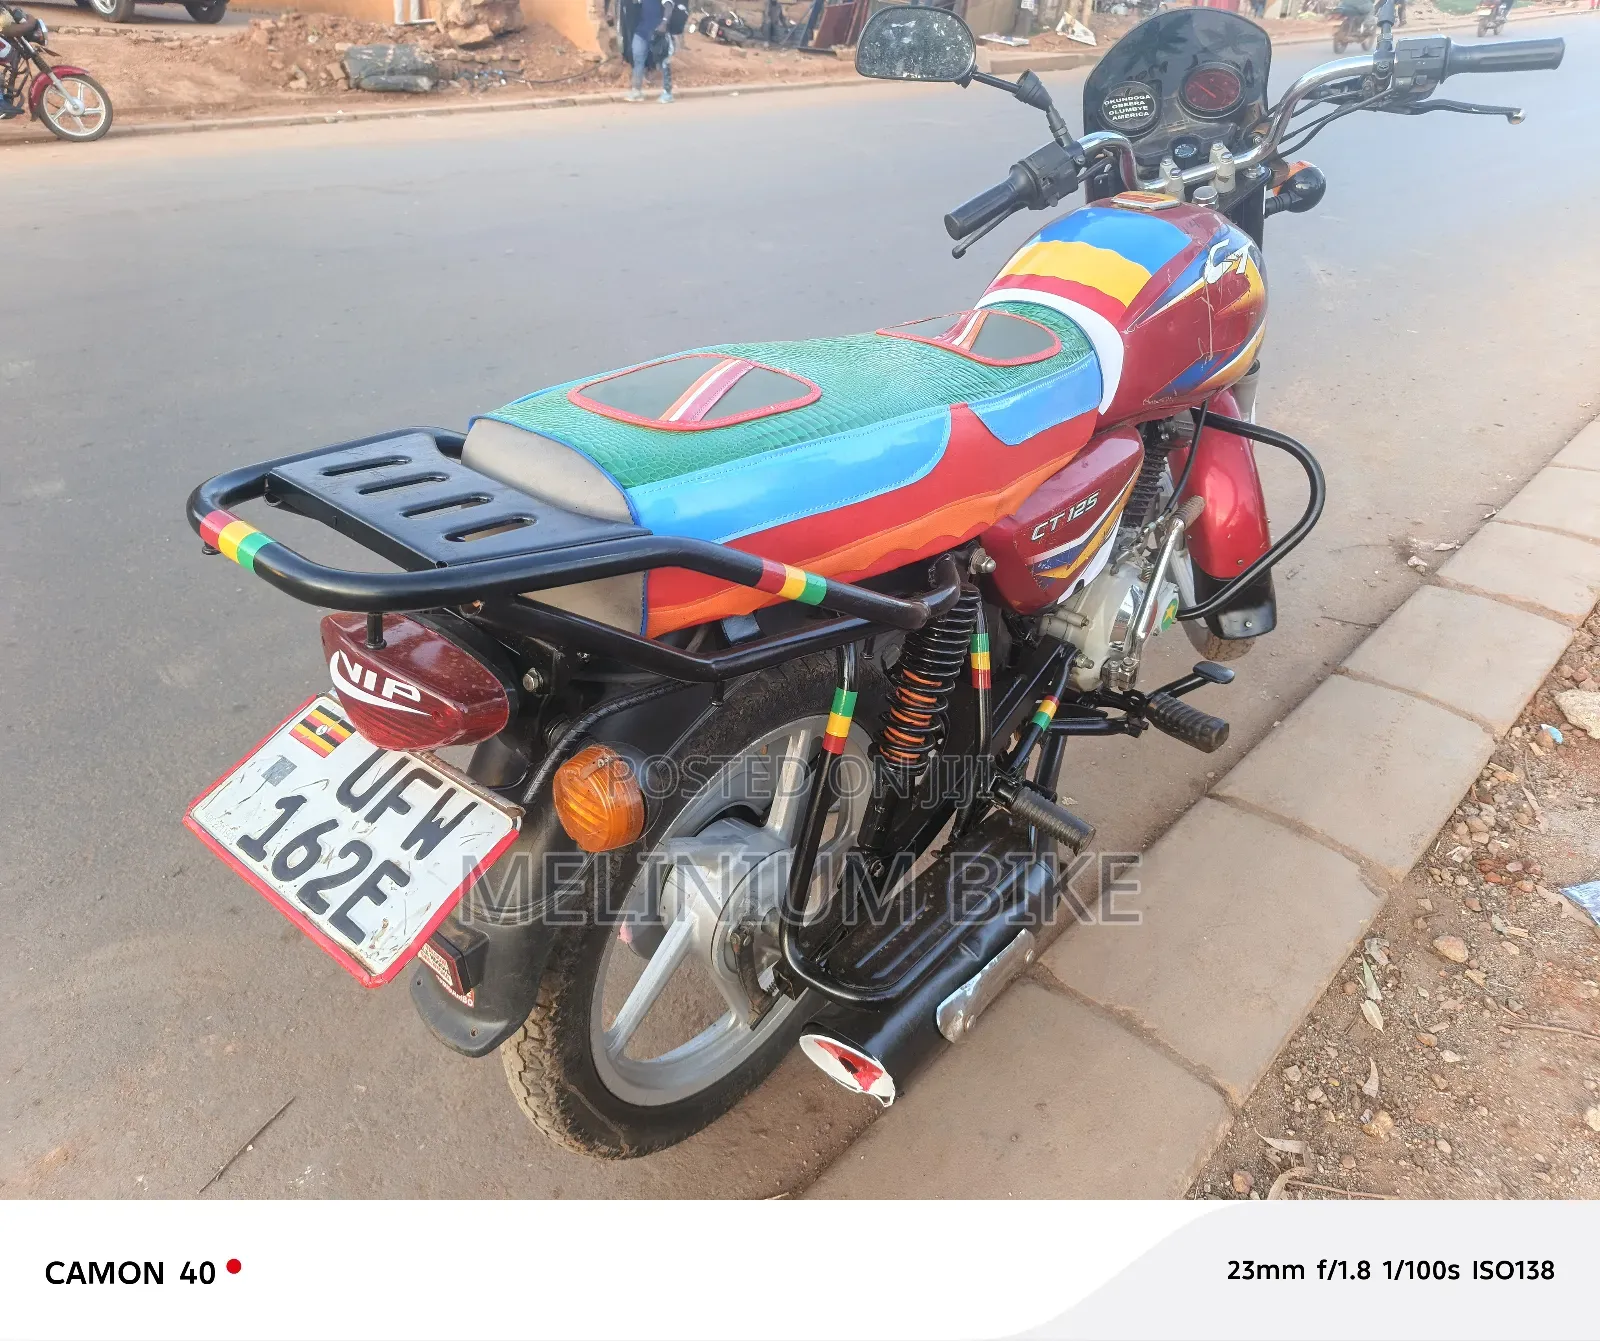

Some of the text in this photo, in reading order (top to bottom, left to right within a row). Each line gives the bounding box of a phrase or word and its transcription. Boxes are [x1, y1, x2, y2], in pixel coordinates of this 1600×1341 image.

[1112, 112, 1149, 121] AMERICA
[1030, 491, 1100, 541] CT 125
[330, 649, 421, 703] VIP
[335, 749, 479, 861] UFW
[236, 795, 411, 945] 162E
